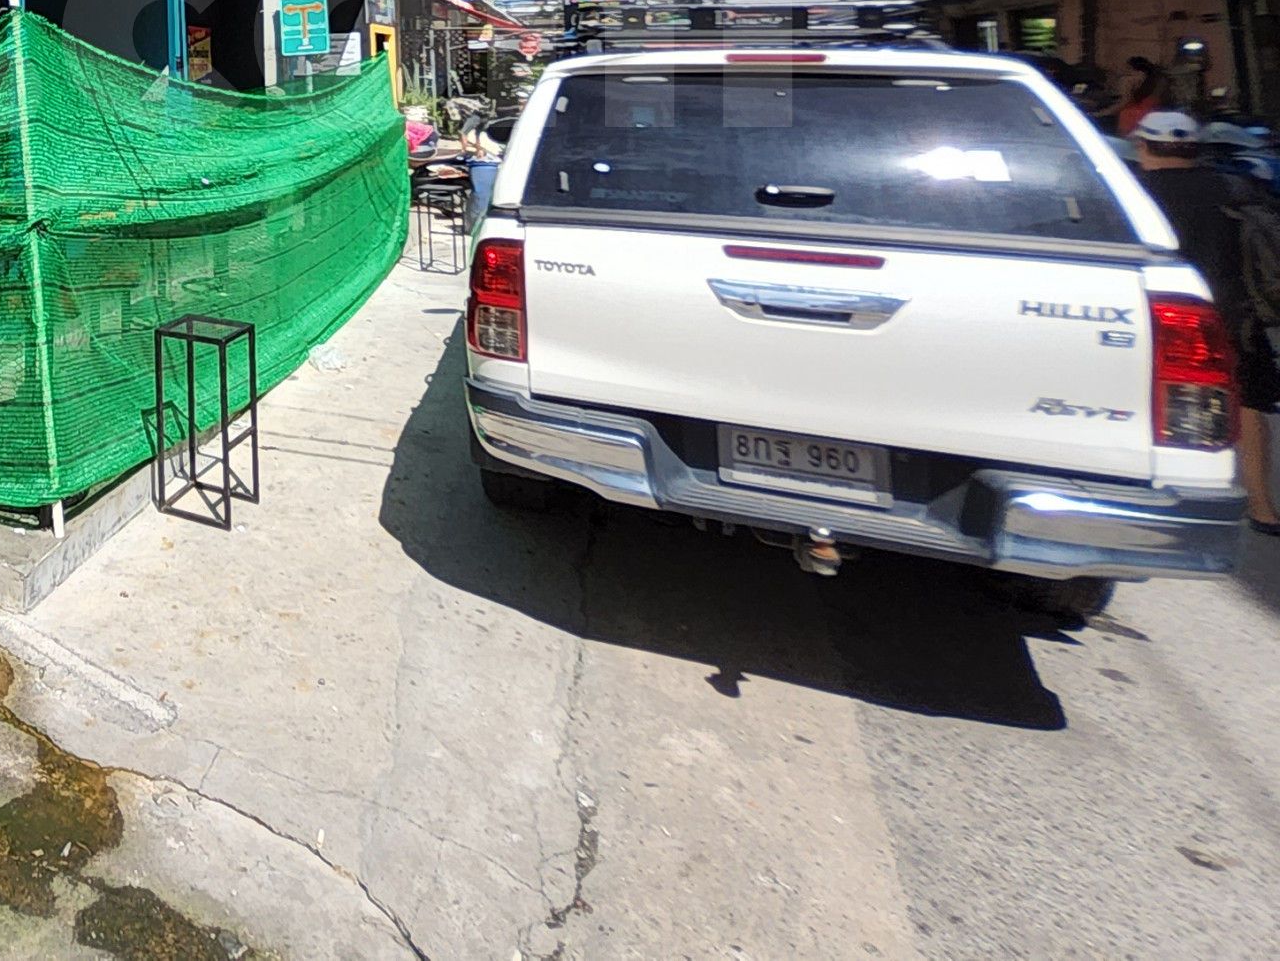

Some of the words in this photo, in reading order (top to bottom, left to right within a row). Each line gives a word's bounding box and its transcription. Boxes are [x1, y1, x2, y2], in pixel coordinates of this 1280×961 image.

[534, 259, 596, 276] TOYOTA
[1018, 300, 1135, 325] HILUX
[807, 444, 860, 473] 960
